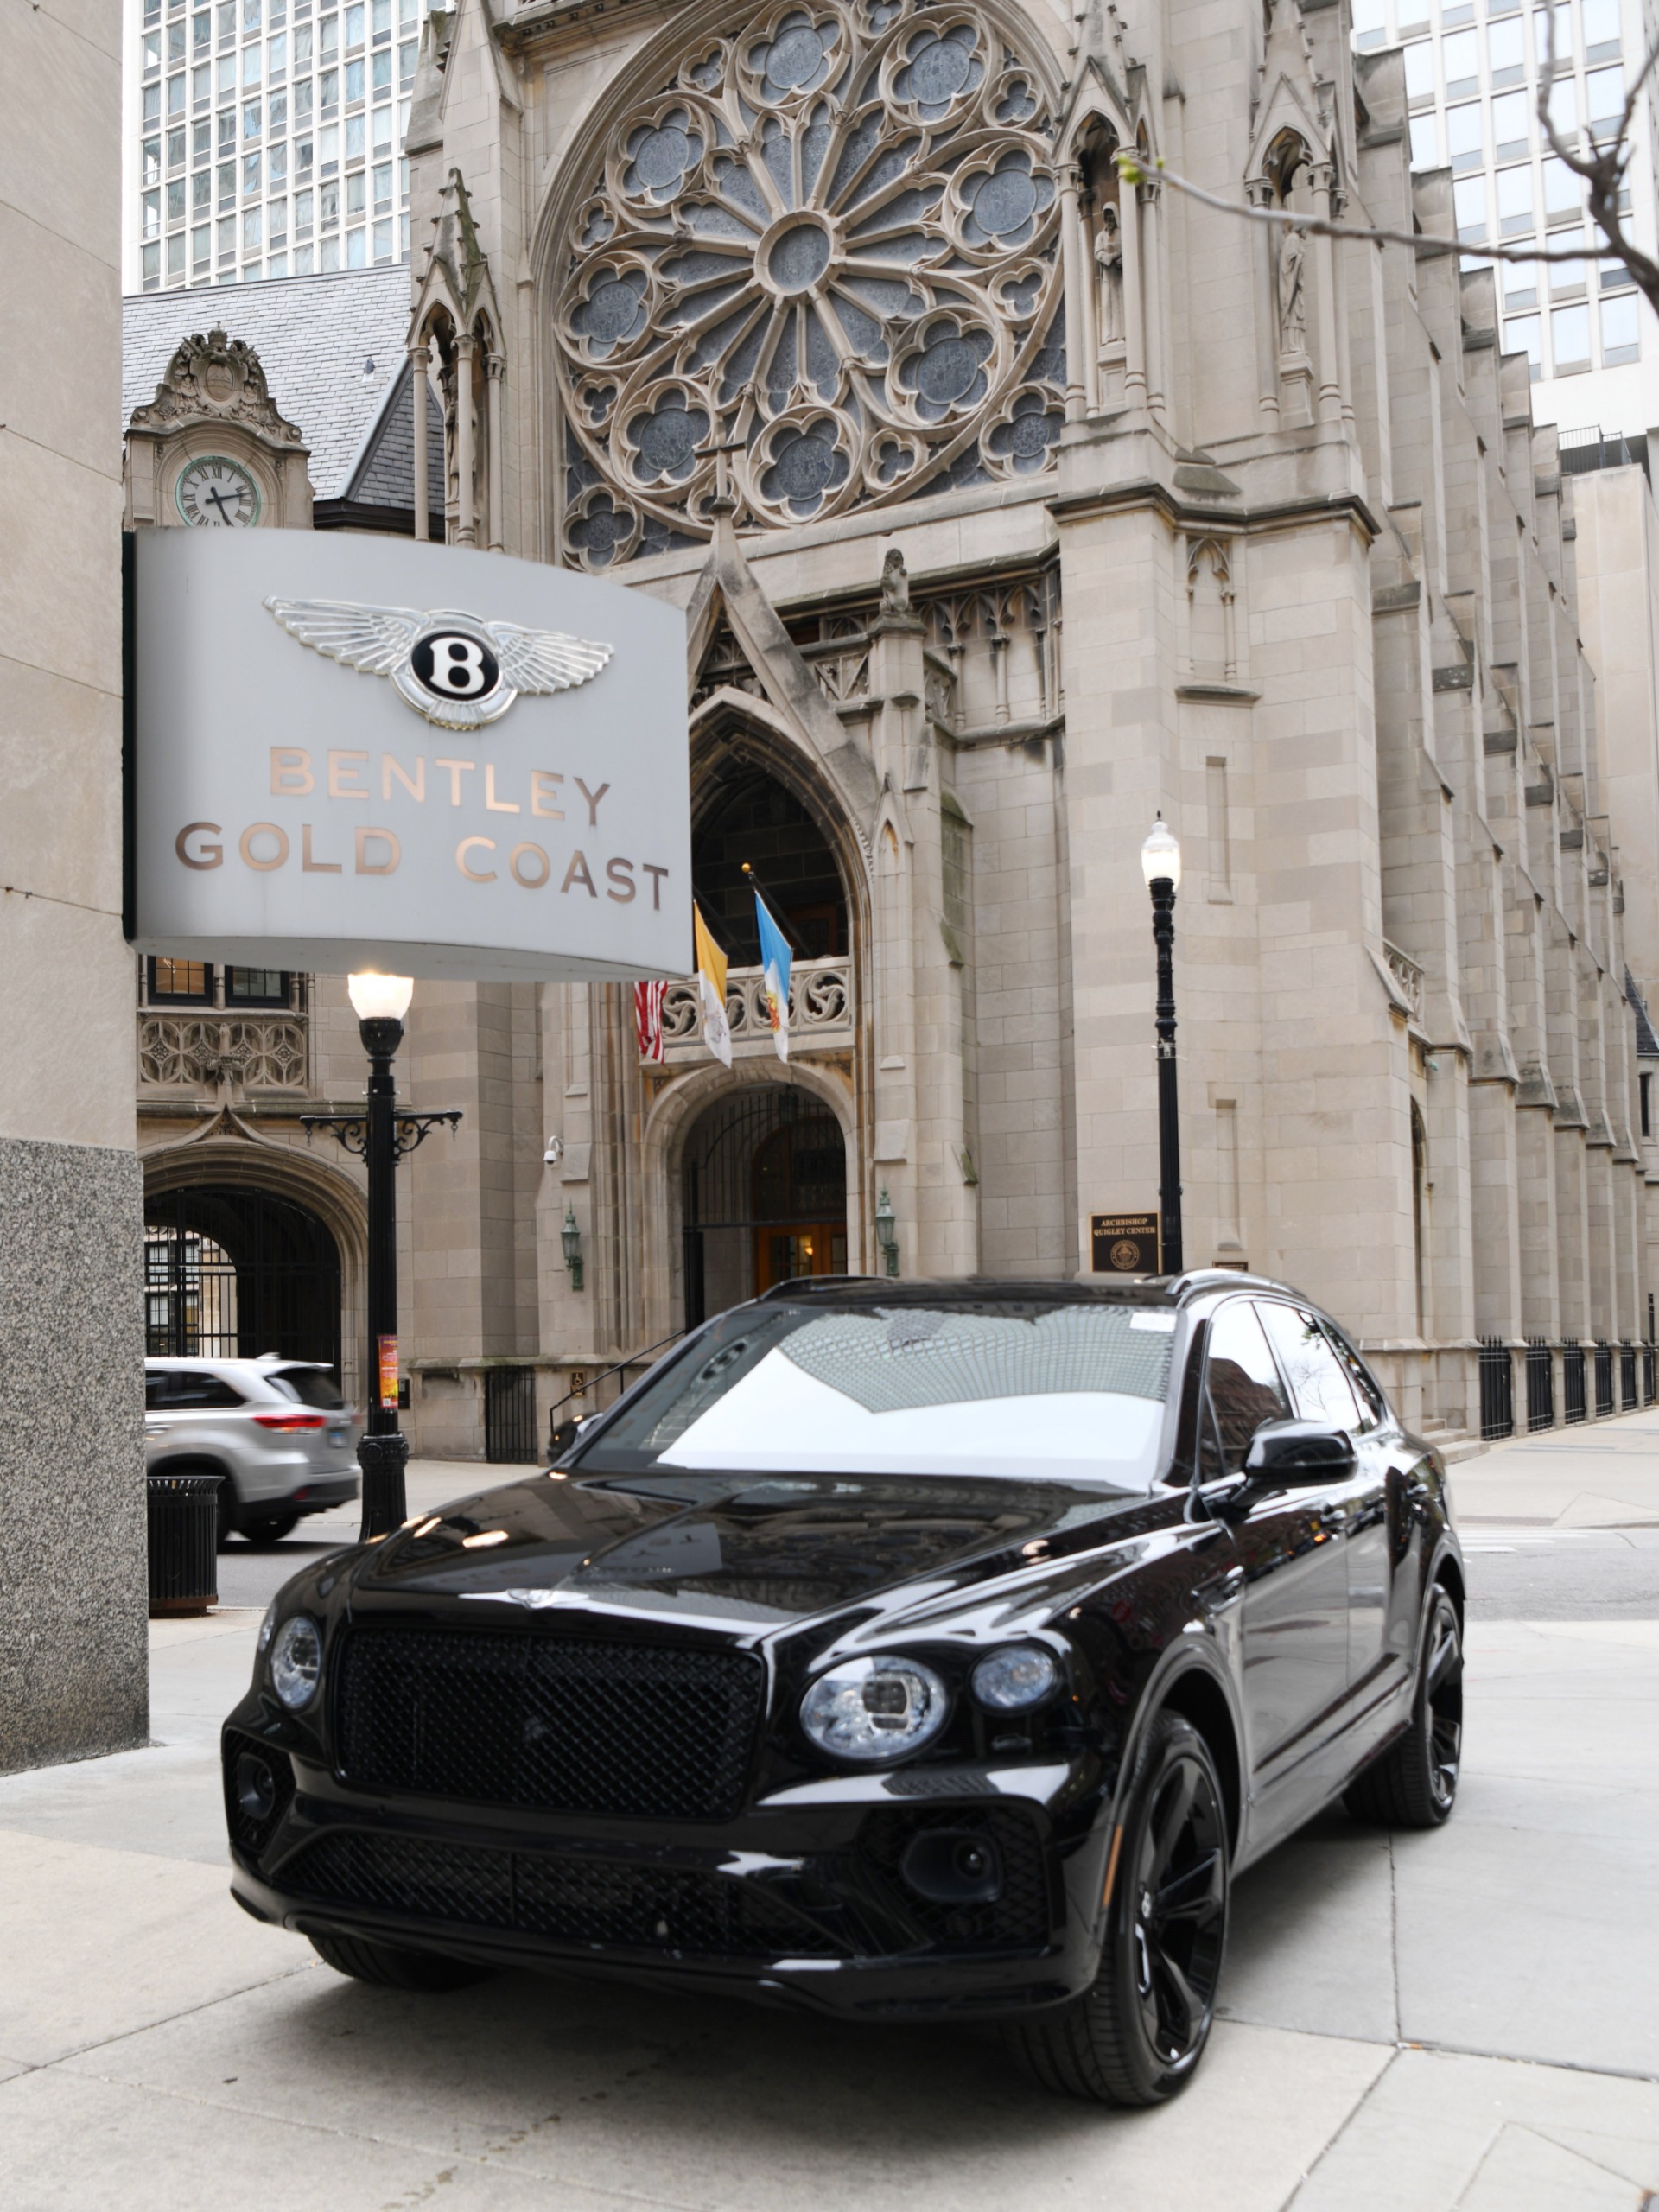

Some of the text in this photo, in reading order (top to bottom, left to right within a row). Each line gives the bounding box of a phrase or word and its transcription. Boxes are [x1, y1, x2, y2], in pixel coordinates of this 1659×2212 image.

[429, 636, 486, 695] B
[269, 746, 612, 827] BENTLEY
[175, 821, 670, 912] GOLD COAST
[1093, 1226, 1155, 1237] QUIGLEY CENTER
[1101, 1217, 1148, 1227] ARCHBISHOP
